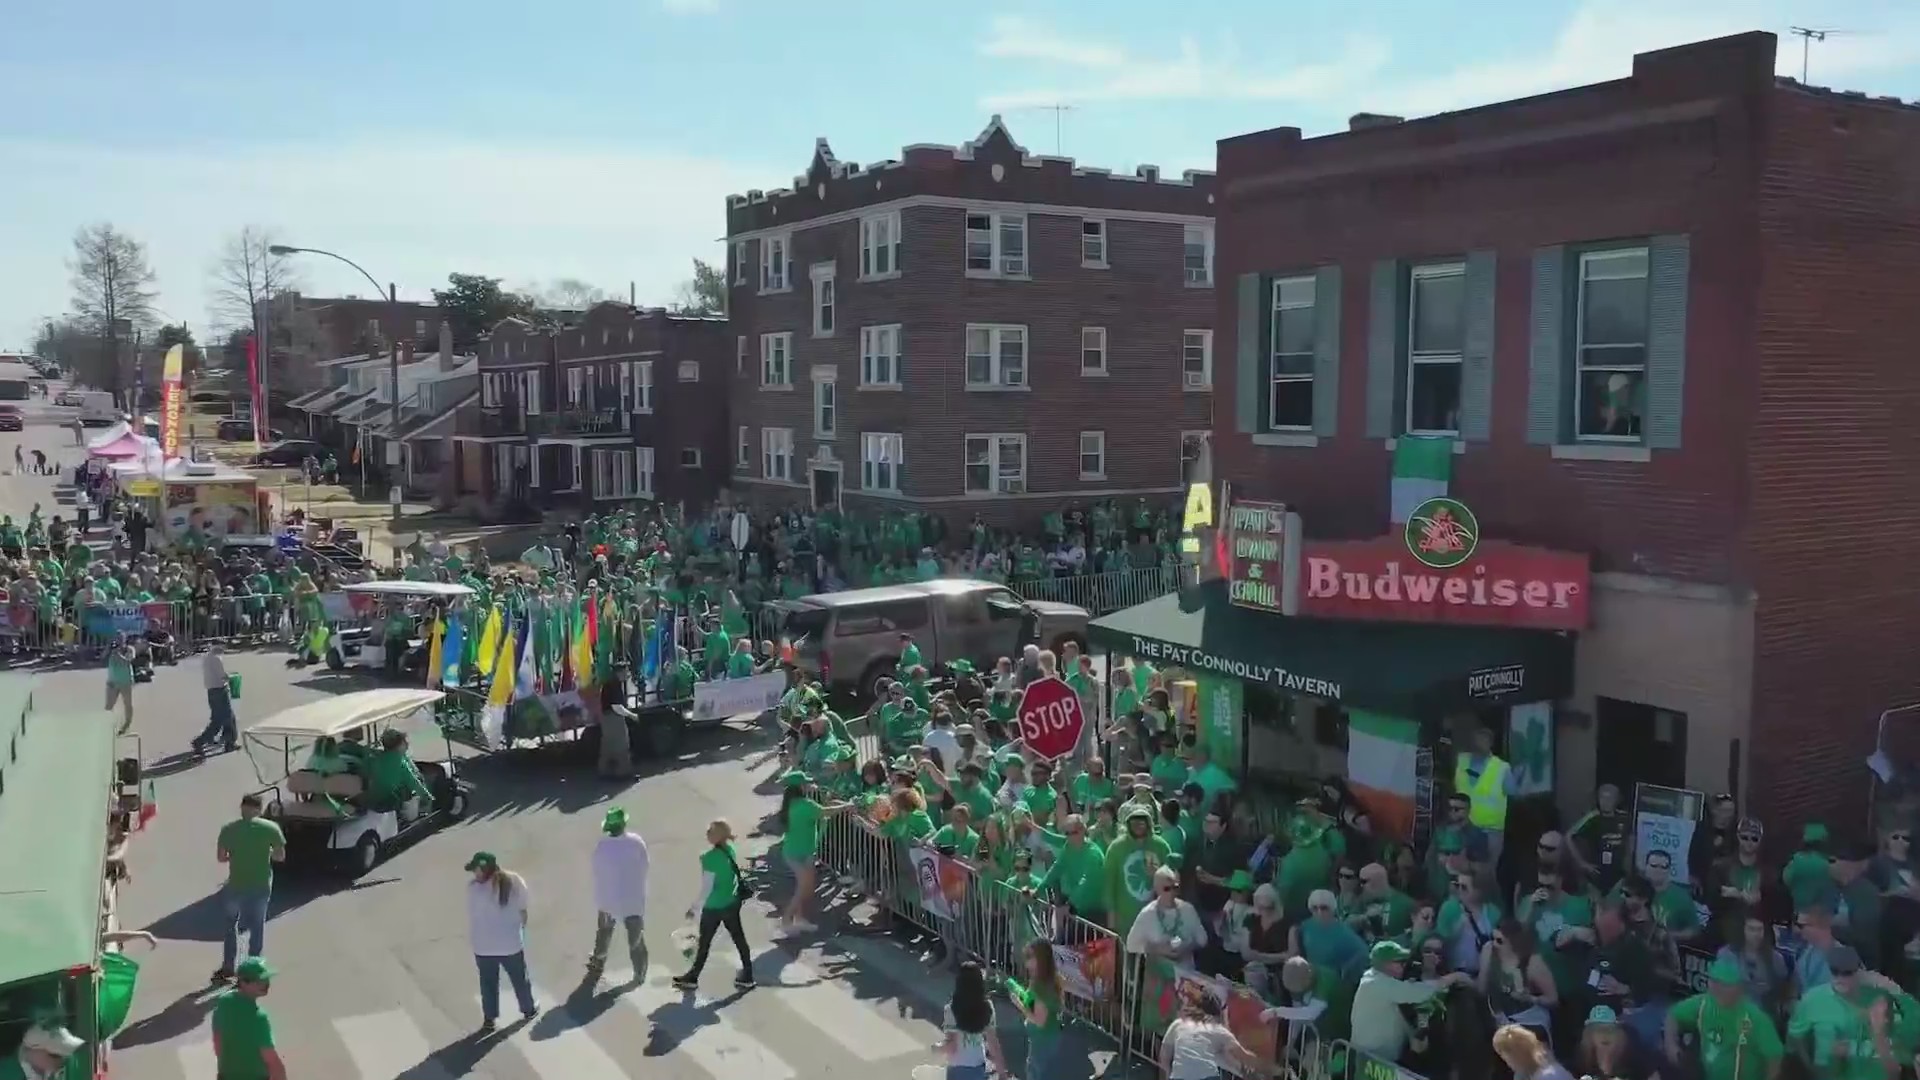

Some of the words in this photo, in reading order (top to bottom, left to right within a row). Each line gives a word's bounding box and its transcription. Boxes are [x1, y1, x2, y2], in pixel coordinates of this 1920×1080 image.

[1307, 557, 1580, 609] Budweiser
[1132, 636, 1159, 656] THE
[1162, 643, 1190, 664] PAT
[1191, 650, 1272, 681] CONNOLLY
[1274, 668, 1341, 700] TAVERN
[1024, 697, 1075, 739] STOP
